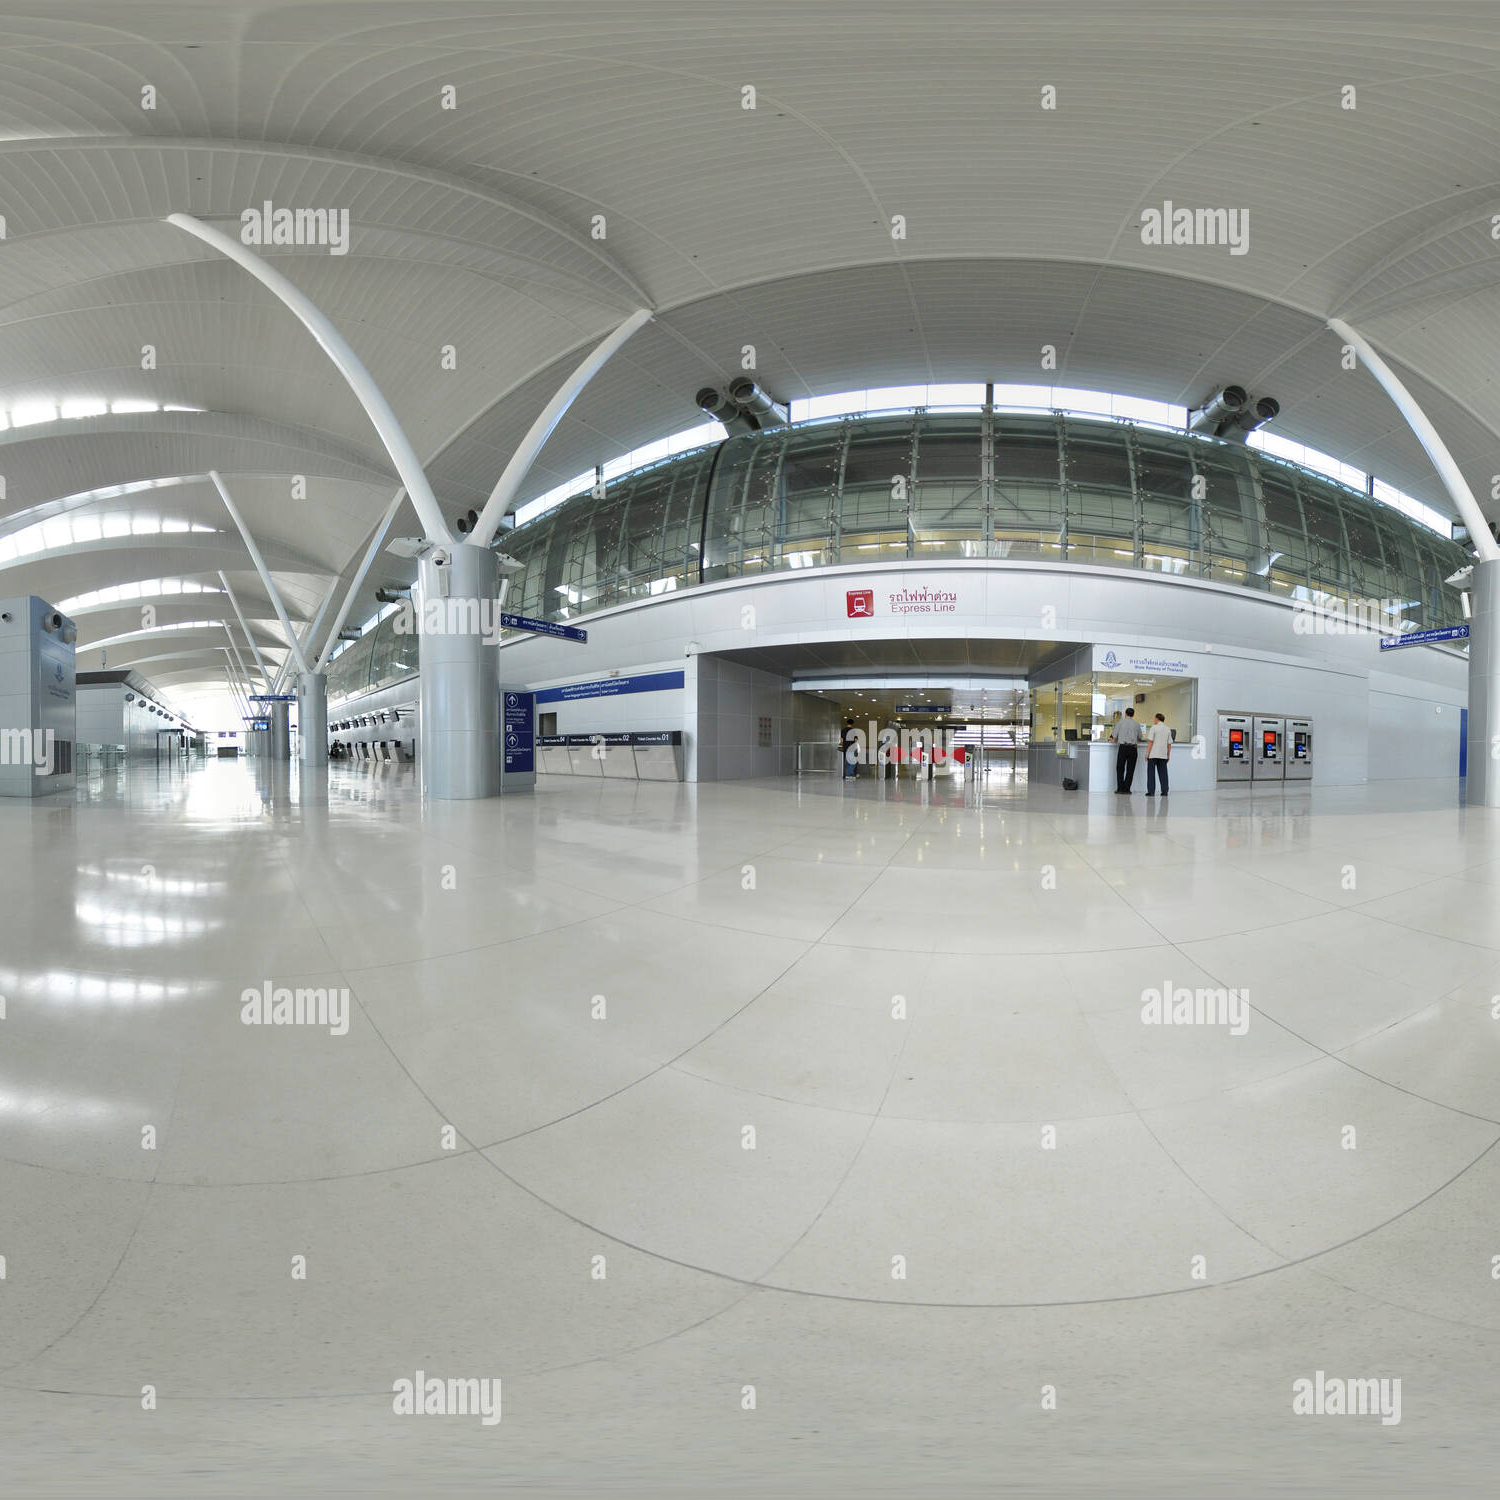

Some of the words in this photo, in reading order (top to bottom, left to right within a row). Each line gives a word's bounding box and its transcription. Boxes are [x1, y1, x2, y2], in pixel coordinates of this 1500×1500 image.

[889, 586, 957, 602] รถไฟฟ้าด่วน
[891, 604, 931, 614] Express
[934, 603, 956, 612] Line
[661, 733, 669, 741] 01
